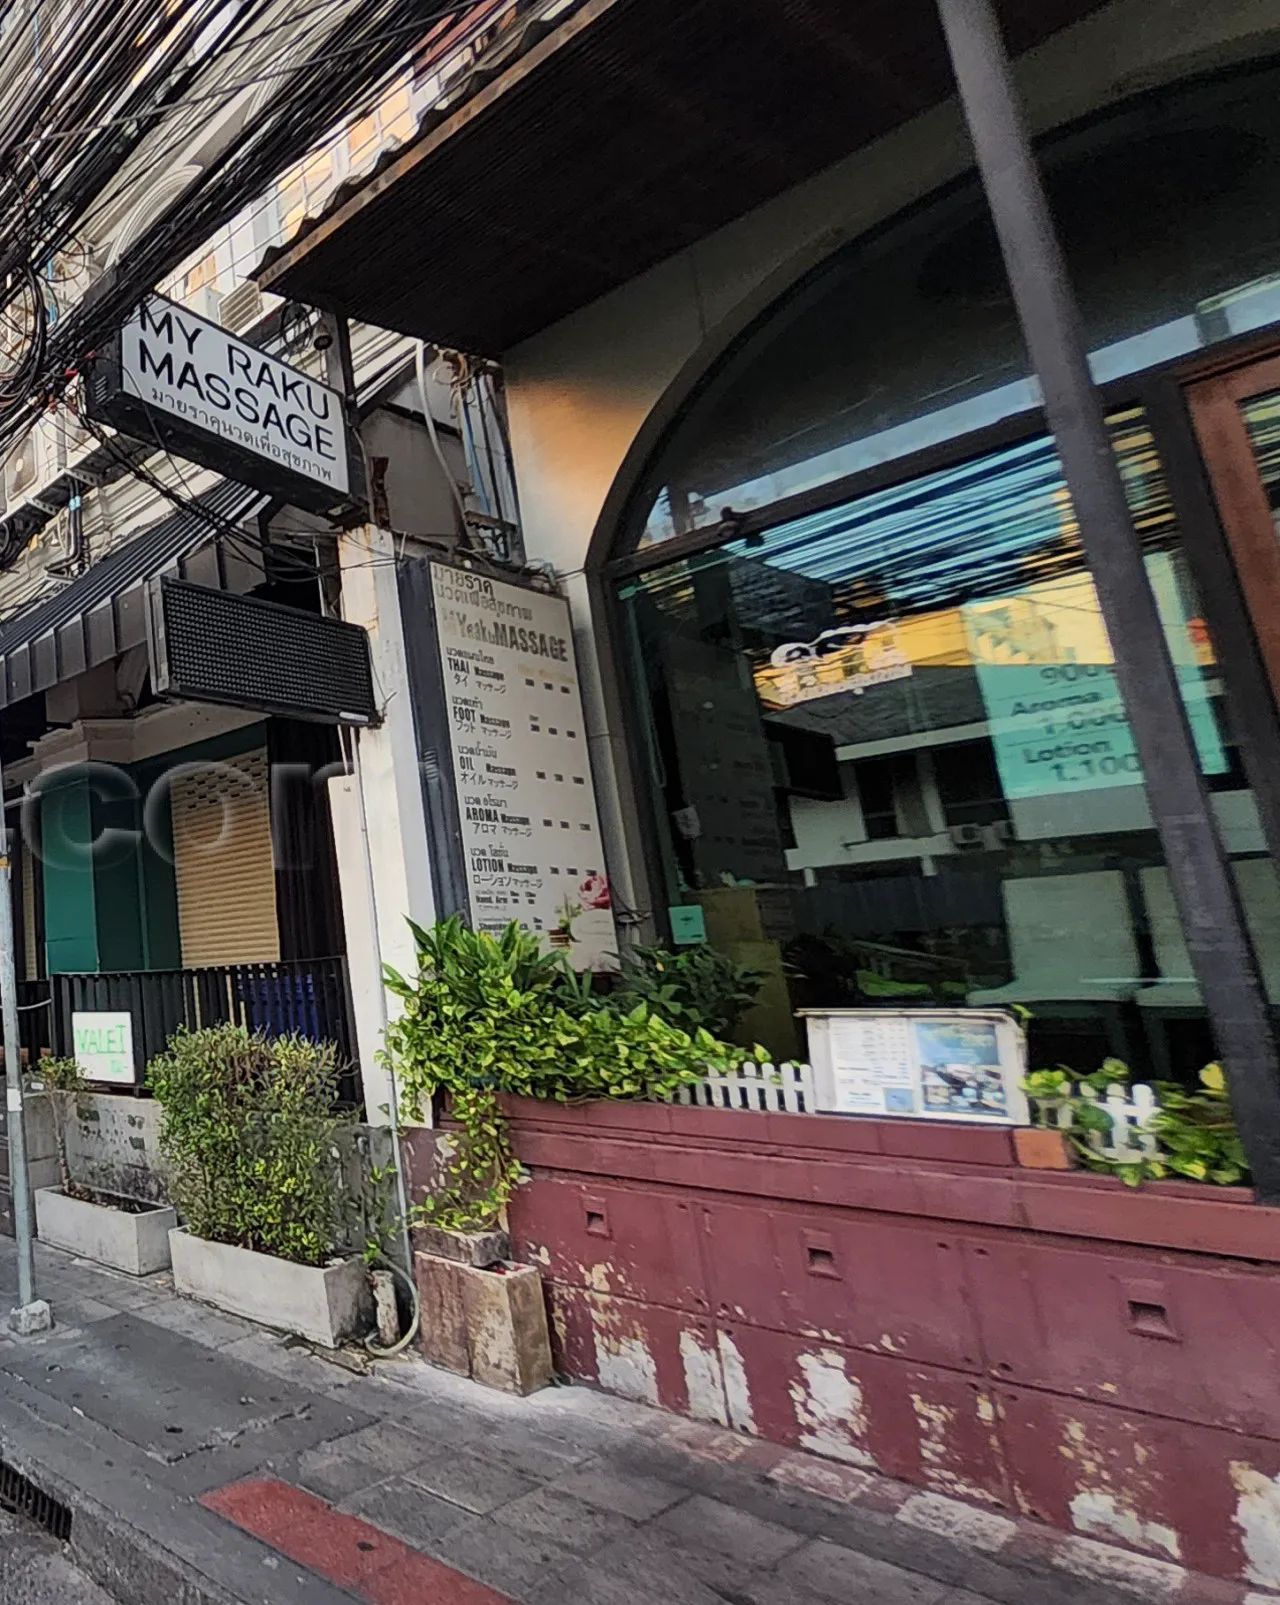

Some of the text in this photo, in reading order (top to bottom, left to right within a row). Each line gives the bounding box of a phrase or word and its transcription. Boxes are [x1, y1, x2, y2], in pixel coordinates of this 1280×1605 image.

[140, 302, 329, 420] MY RAKU
[138, 338, 336, 461] MASSAGE
[493, 621, 569, 662] MASSAGE
[447, 657, 470, 675] THAI
[453, 706, 476, 722] FOOT
[1011, 692, 1104, 716] Aroma
[1022, 741, 1114, 764] Lotion
[459, 756, 475, 771] OIL
[466, 807, 500, 823] AROMA
[471, 857, 505, 873] LOTION
